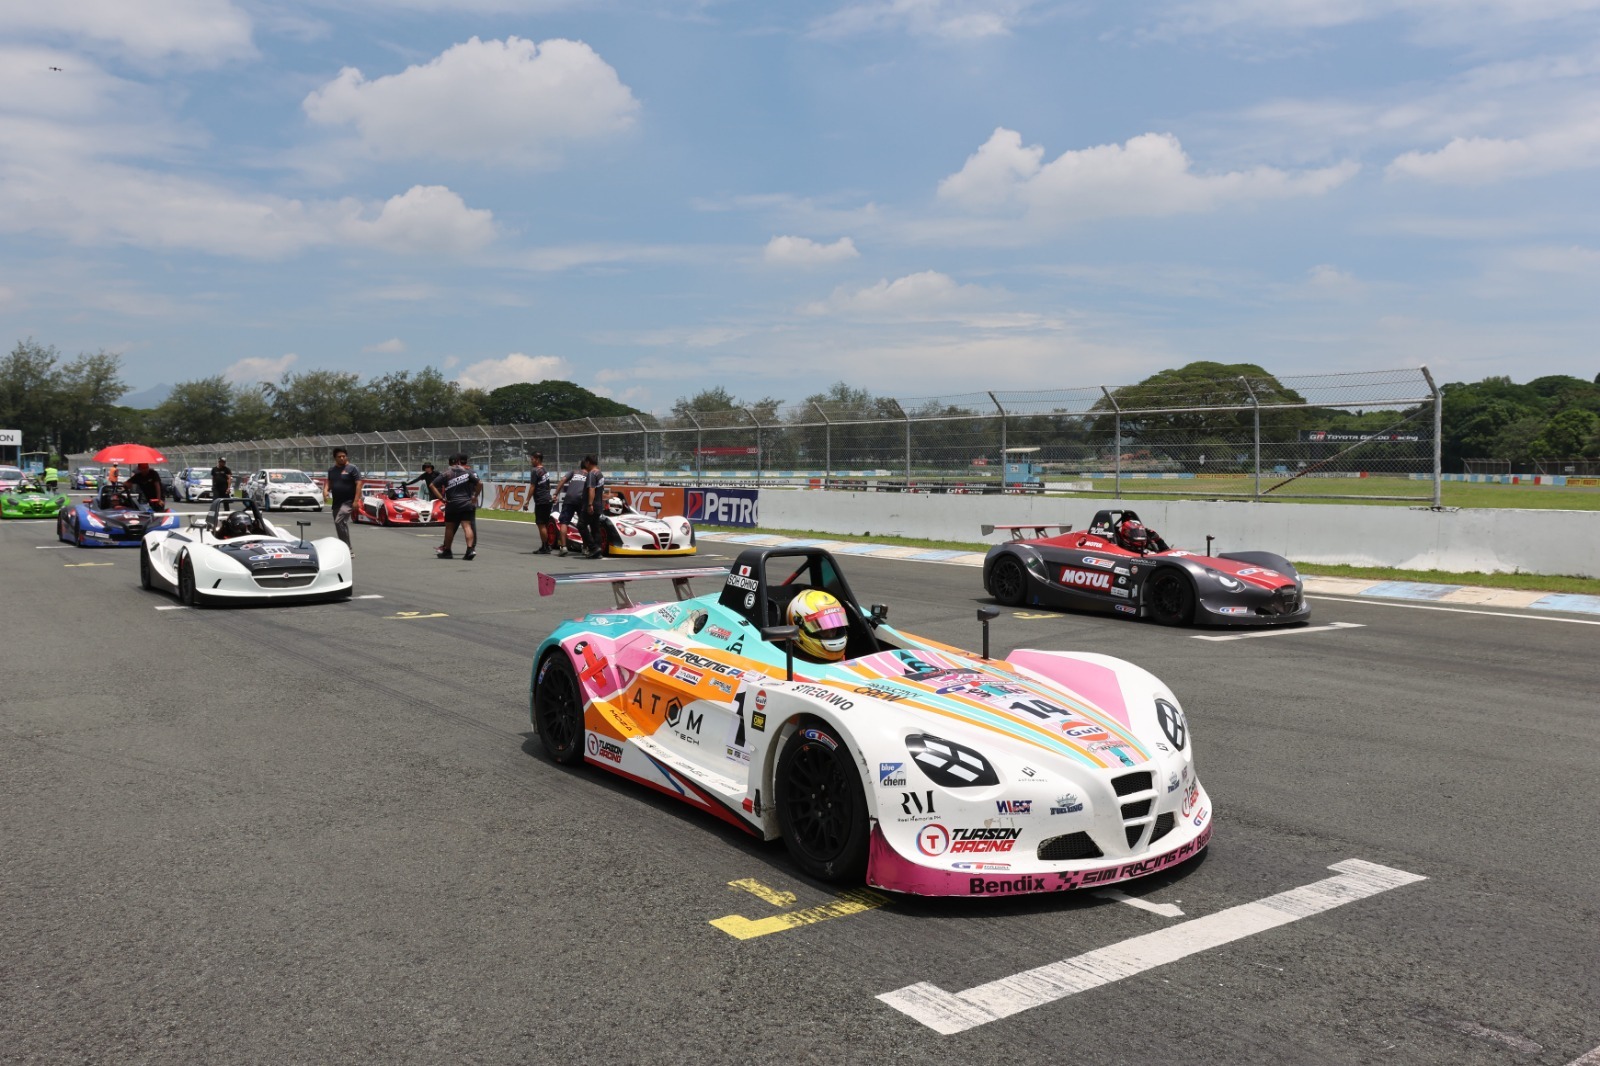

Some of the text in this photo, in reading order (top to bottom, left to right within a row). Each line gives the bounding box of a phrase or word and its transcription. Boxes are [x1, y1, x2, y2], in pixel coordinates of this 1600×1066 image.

[740, 578, 758, 591] OHNO
[1061, 569, 1110, 589] MOTUL
[1118, 576, 1127, 585] 6
[661, 645, 685, 658] SIM
[680, 651, 731, 674] RACING
[755, 695, 767, 705] Gulf
[791, 683, 855, 711] STREGAWO
[1009, 699, 1073, 720] 14
[674, 730, 700, 747] TECH
[1066, 726, 1104, 738] Gulf
[881, 763, 895, 771] blue
[883, 775, 906, 787] chem
[952, 827, 1023, 841] TUASON
[950, 839, 1016, 854] RACING
[1080, 841, 1194, 885] SIM RACING PH
[969, 875, 1046, 895] Bendix
